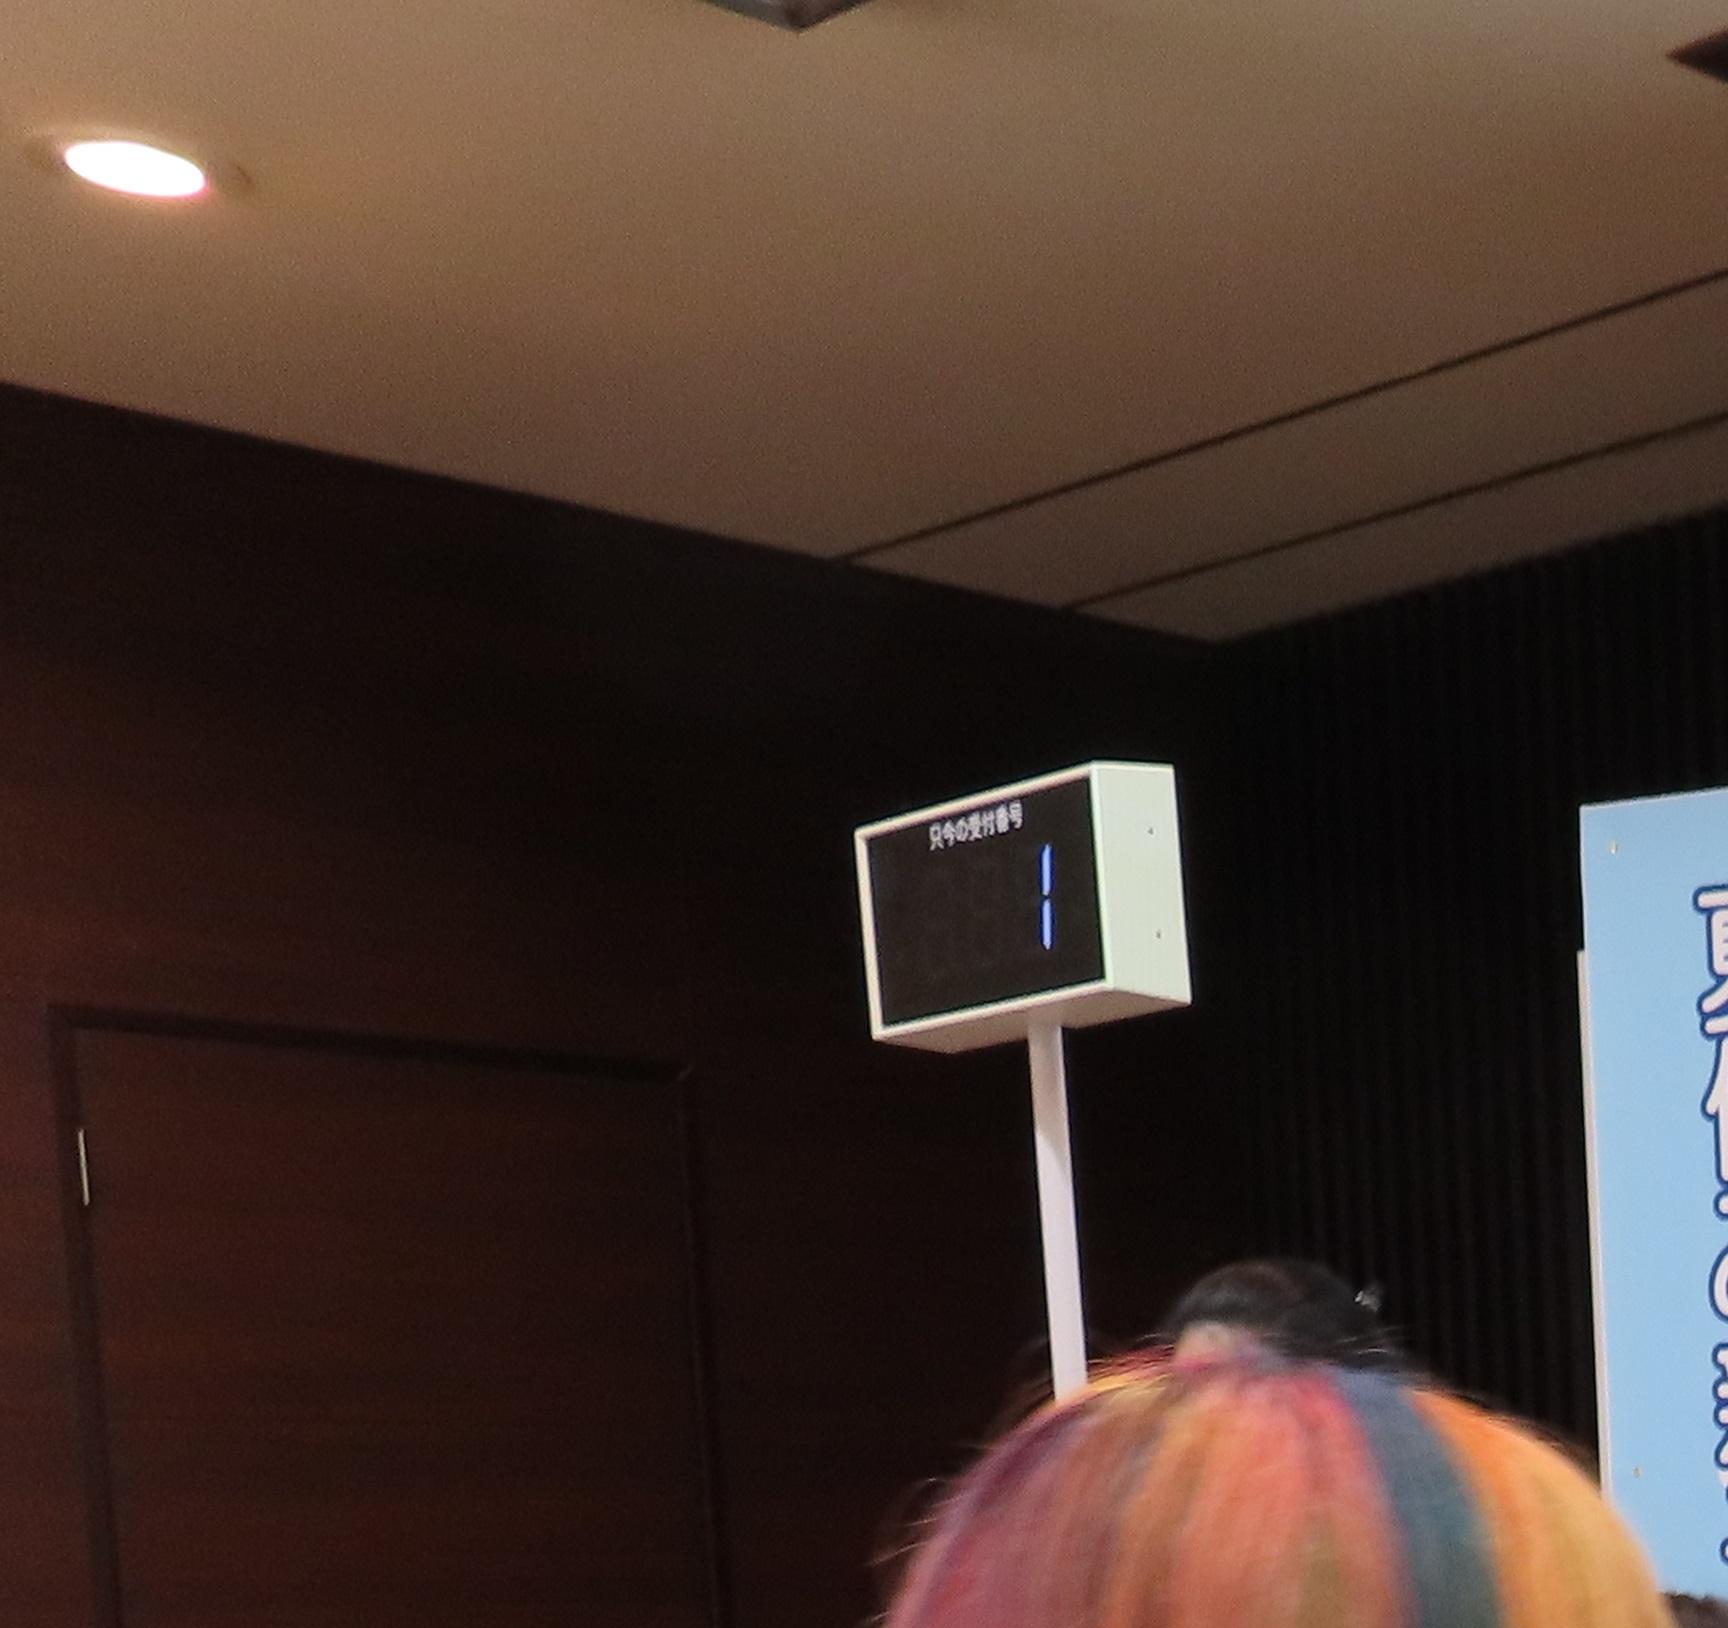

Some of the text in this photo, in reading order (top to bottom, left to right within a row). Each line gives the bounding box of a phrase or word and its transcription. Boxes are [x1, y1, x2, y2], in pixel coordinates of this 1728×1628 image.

[930, 799, 1024, 851] 只今の受付番号
[1039, 842, 1055, 951] 1
